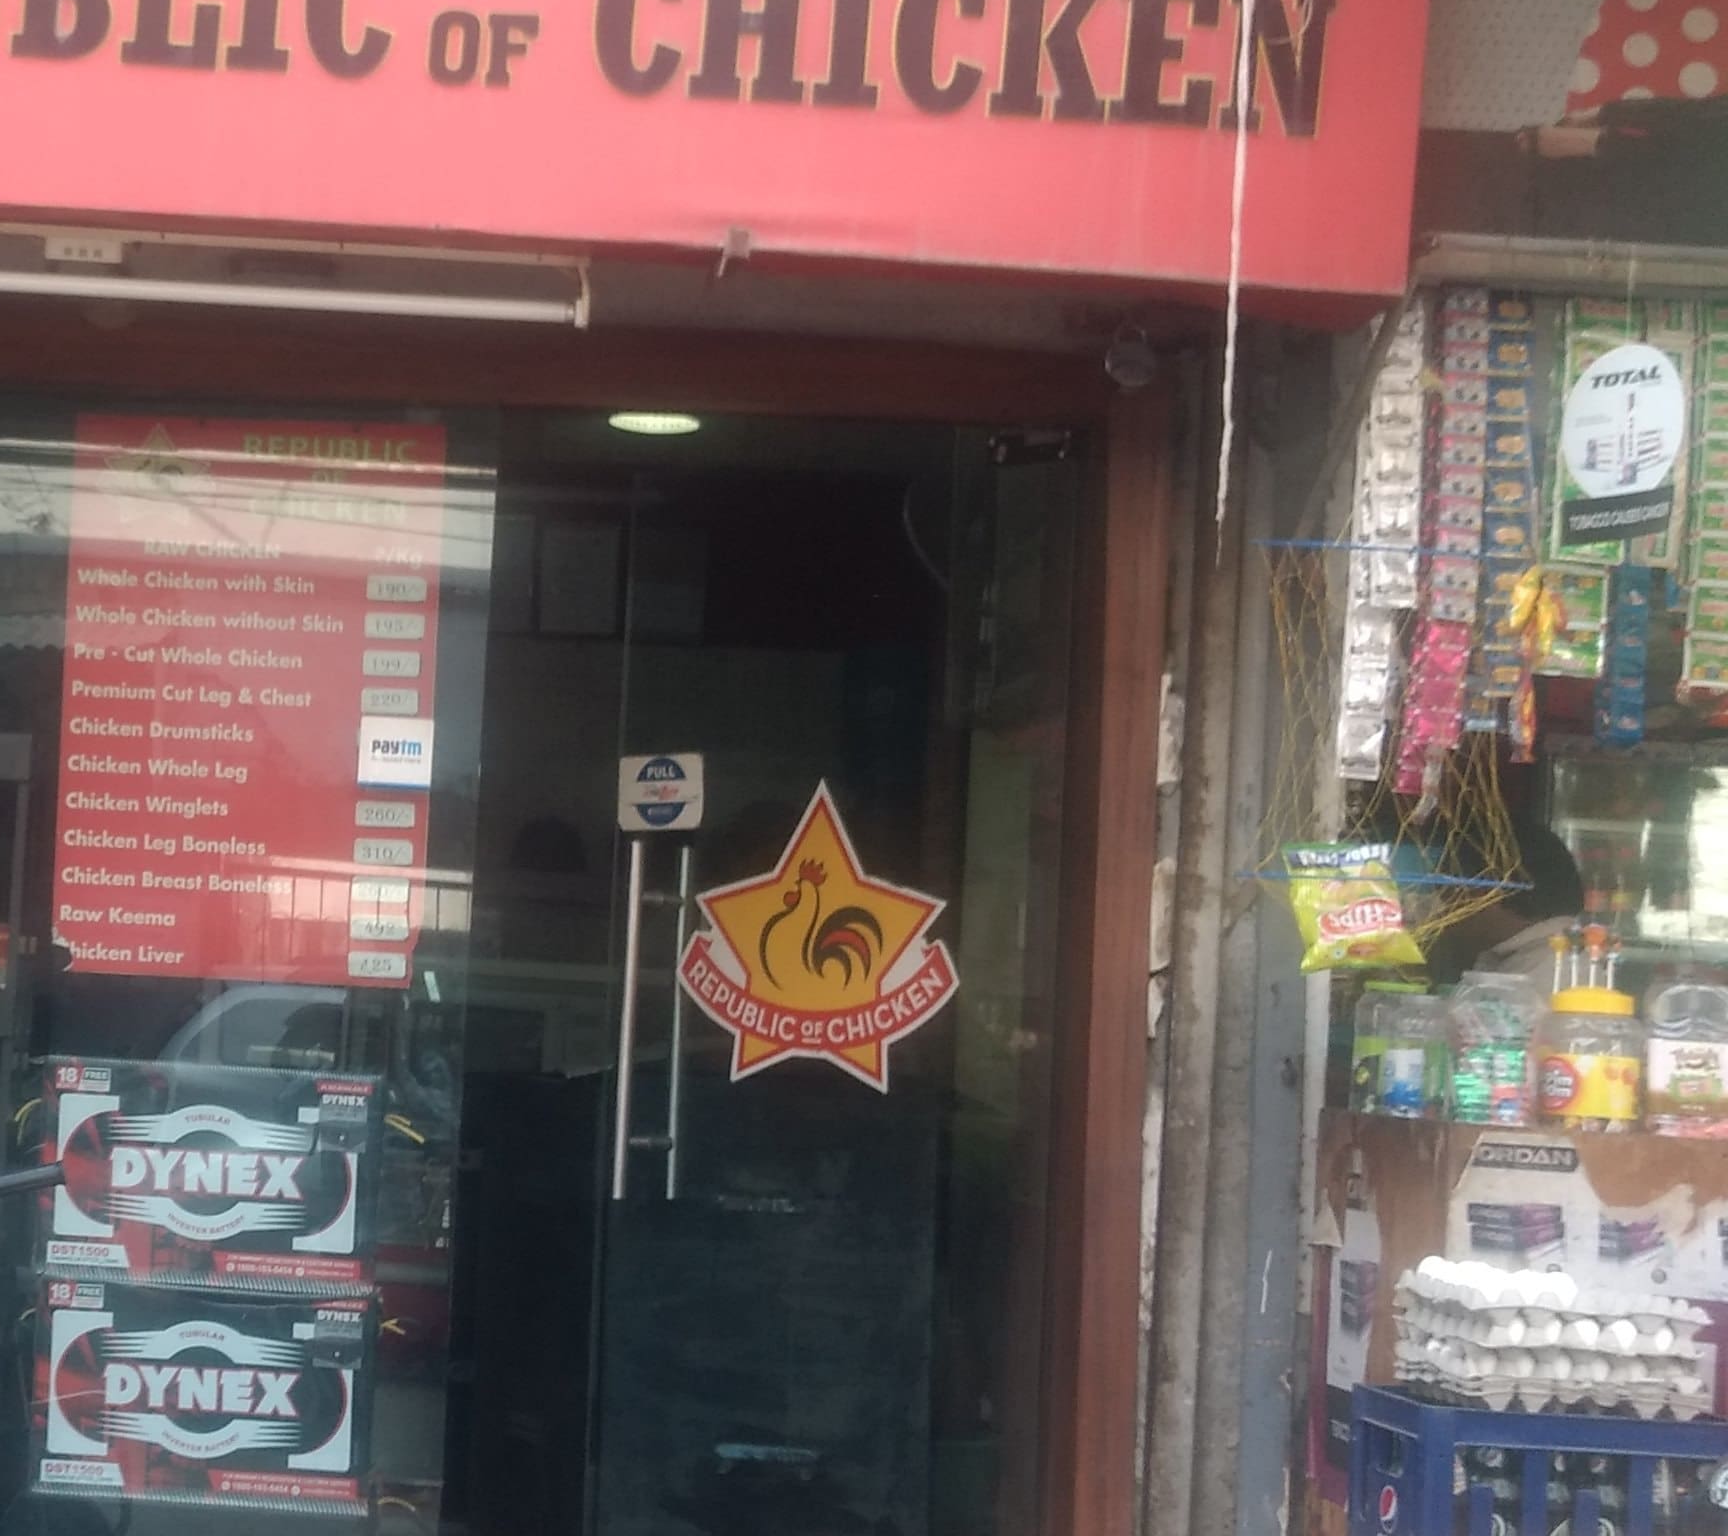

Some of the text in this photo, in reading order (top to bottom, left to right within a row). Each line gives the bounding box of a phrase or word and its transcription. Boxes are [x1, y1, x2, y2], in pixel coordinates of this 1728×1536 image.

[427, 9, 540, 88] OF
[1591, 365, 1662, 389] TOTAL
[242, 433, 419, 466] REPUBLIC
[250, 495, 409, 524] CHICKEN
[143, 540, 281, 562] RAW CHICKEN
[77, 569, 315, 595] Whole Chicken with Skin
[75, 605, 344, 633] Whole Chicken without Skin
[73, 643, 105, 661] Pre
[124, 646, 156, 663] Cut
[162, 647, 222, 666] Whole
[228, 650, 304, 669] Chicken
[72, 680, 312, 707] Premium Cut Leg & Chest
[69, 718, 254, 742] Chicken Drumsticks
[371, 739, 422, 756] paytm
[67, 755, 248, 783] Chicken Whole Leg
[646, 764, 676, 779] PULL
[65, 792, 228, 819] Chicken Winglets
[63, 829, 266, 856] Chicken Leg Boneless
[61, 867, 292, 895] Chicken Breast Boneless
[59, 905, 176, 927] Raw Keema
[70, 942, 184, 965] hicken Liver
[688, 964, 945, 1044] REPUBLIC OF CHICKEN
[57, 1066, 108, 1083] 18 FREE
[322, 1094, 367, 1108] DYNEX
[110, 1146, 306, 1201] DYNEX
[49, 1284, 102, 1299] 18 FREE
[316, 1310, 361, 1324] DYNEX
[104, 1363, 302, 1417] DYNEX
